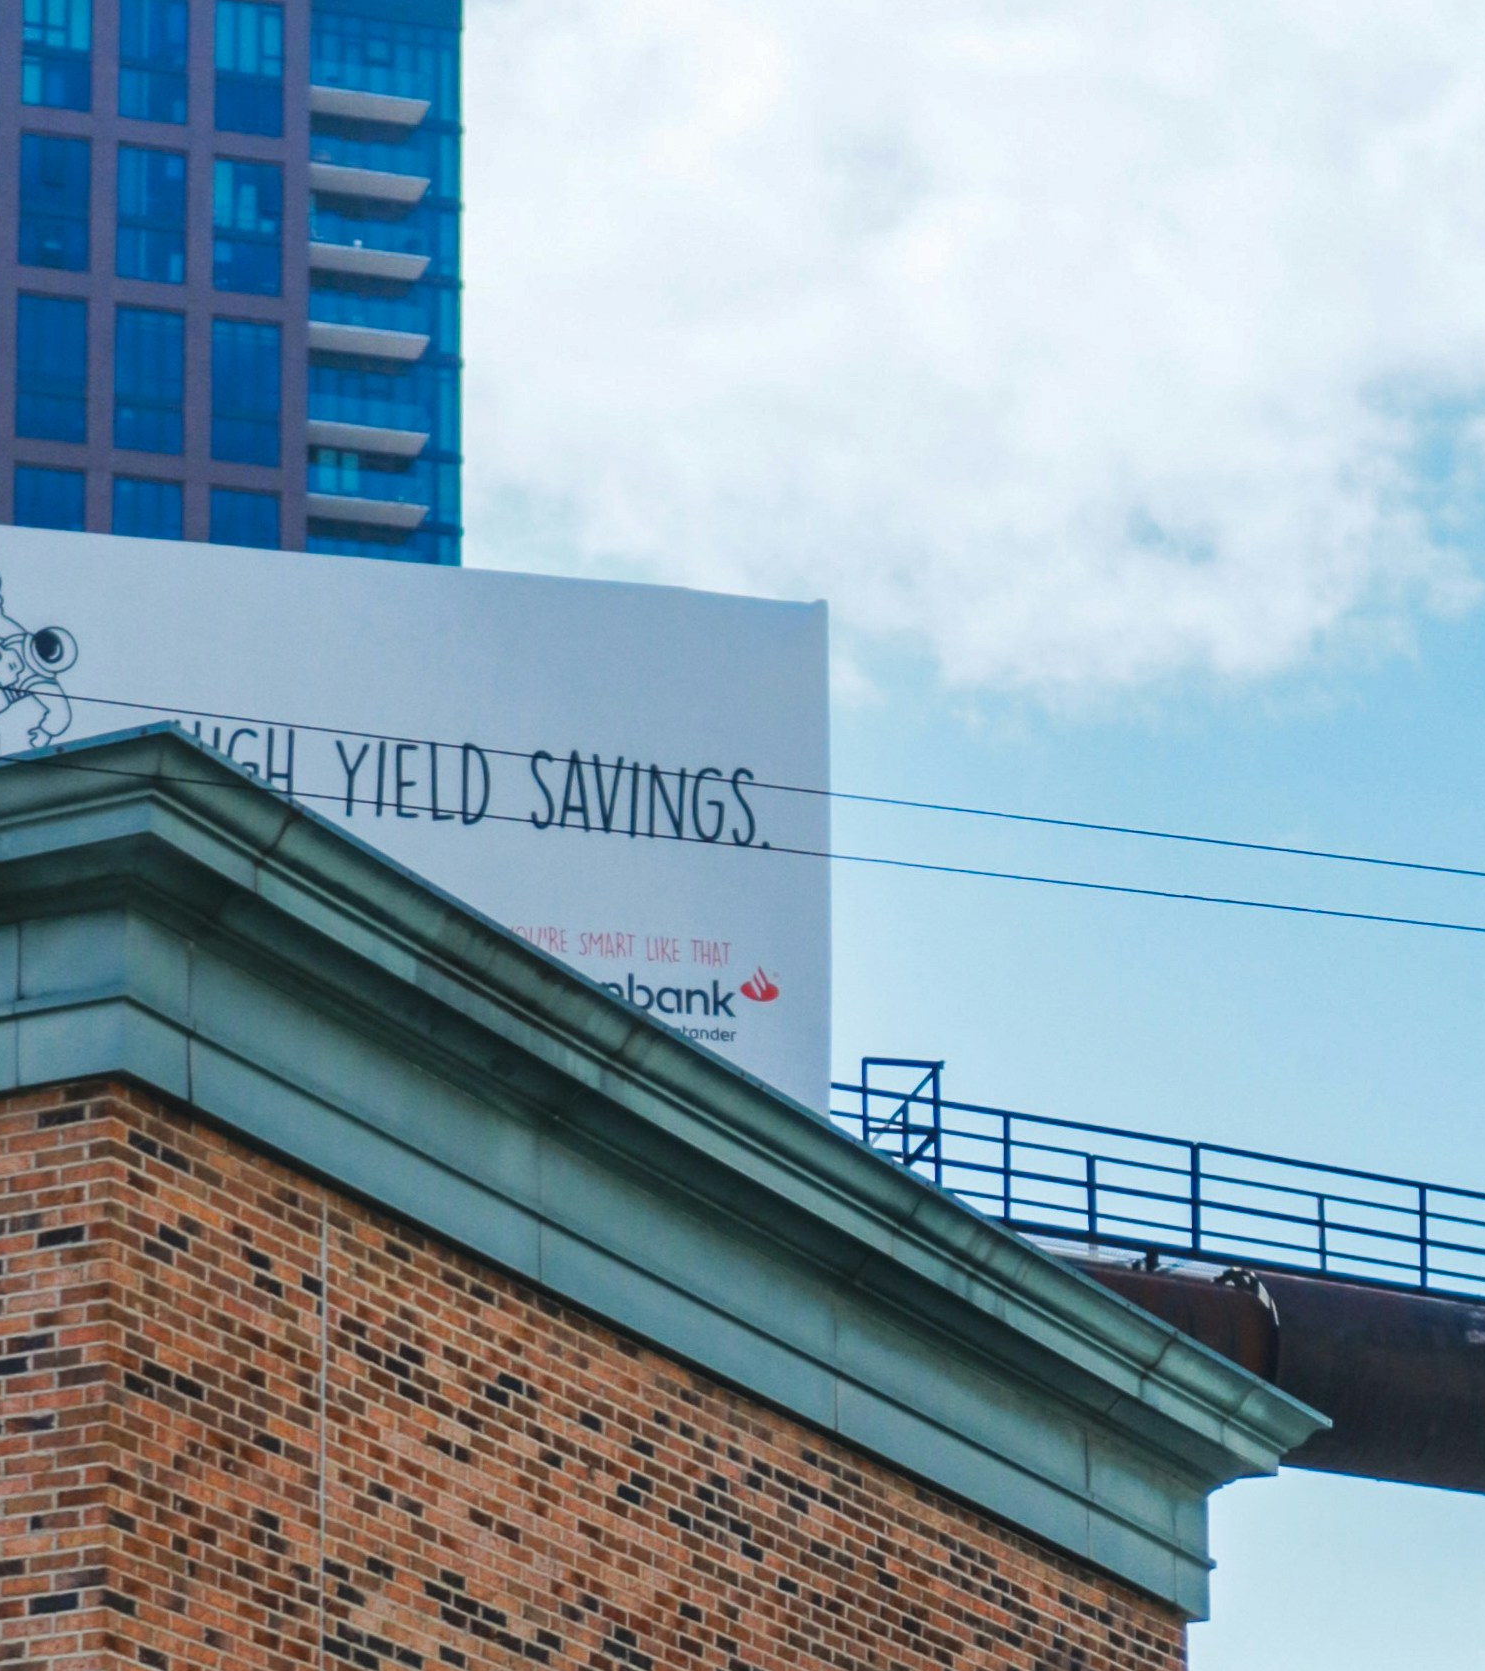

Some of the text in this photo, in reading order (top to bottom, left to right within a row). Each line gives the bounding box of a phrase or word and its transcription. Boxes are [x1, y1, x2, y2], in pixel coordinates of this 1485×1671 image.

[335, 738, 492, 826] YIELD
[530, 749, 771, 850] SAVINGS.
[509, 927, 732, 967] OU'RE SMART LIKE THAT
